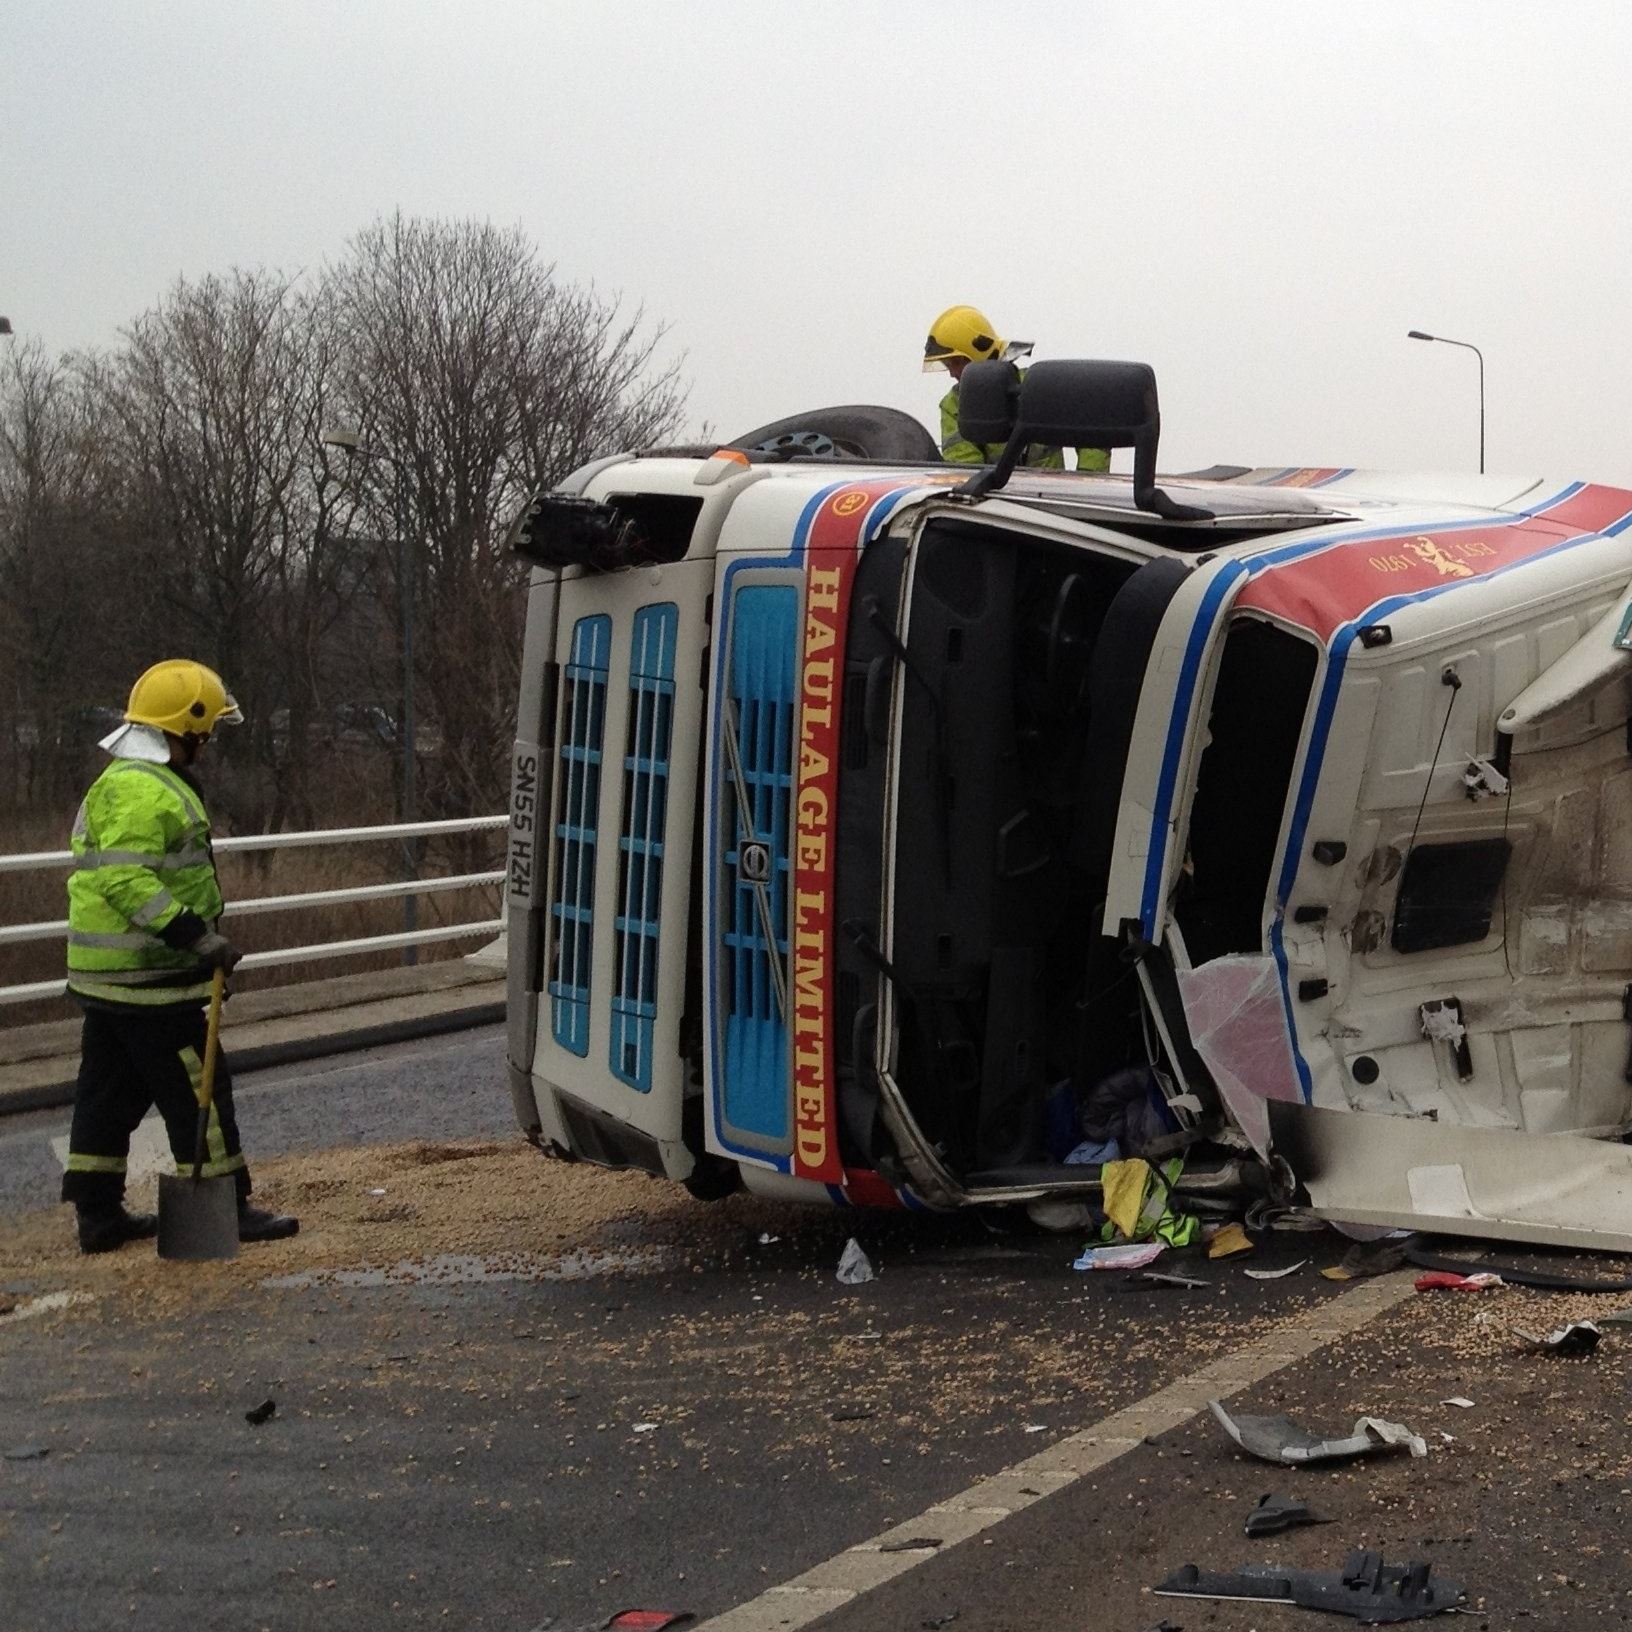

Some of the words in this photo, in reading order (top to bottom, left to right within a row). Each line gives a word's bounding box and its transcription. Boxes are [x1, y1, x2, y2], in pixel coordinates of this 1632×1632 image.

[513, 755, 537, 833] SN55
[796, 564, 841, 873] HAULAGE
[510, 839, 532, 897] HZH
[795, 888, 827, 1168] LIMITED
